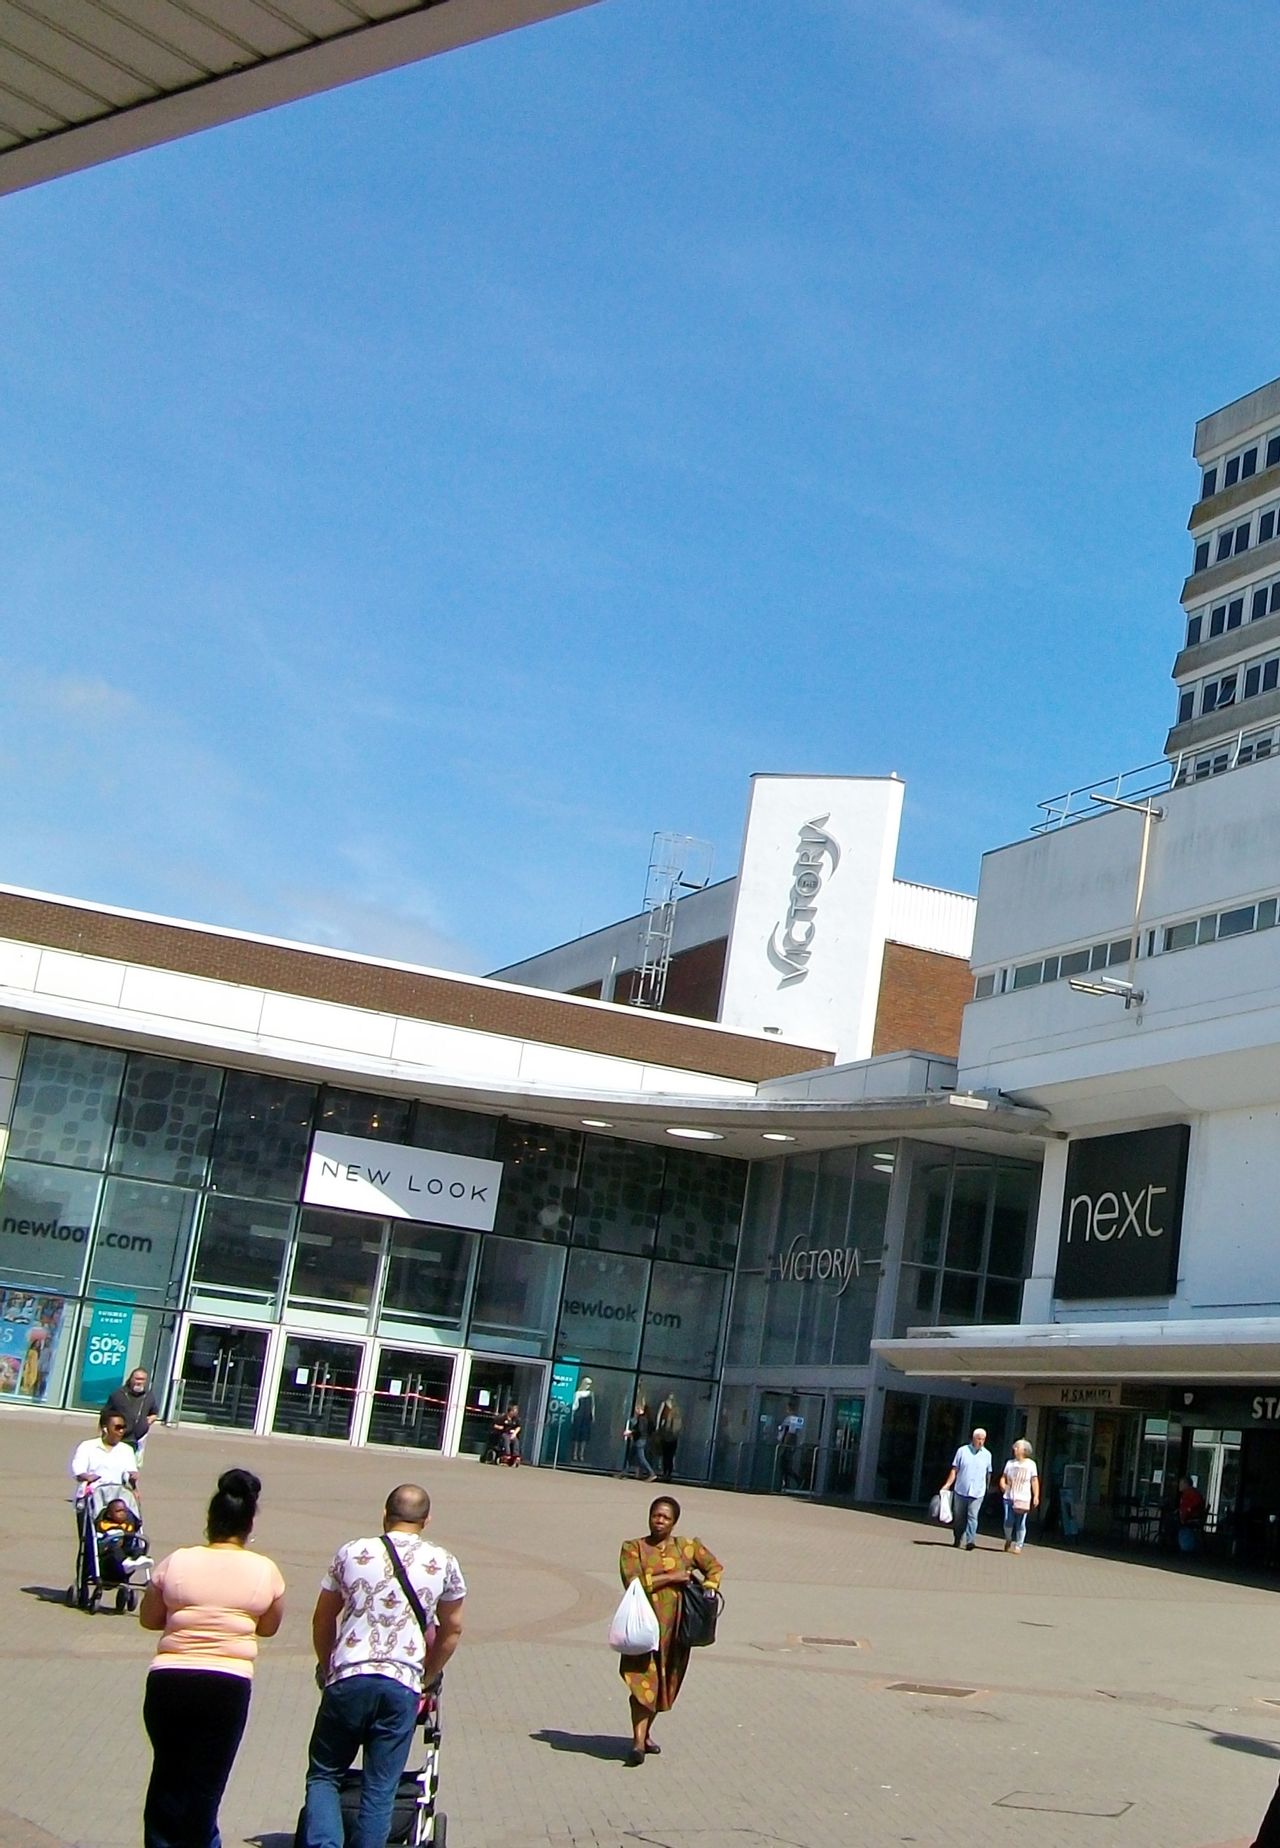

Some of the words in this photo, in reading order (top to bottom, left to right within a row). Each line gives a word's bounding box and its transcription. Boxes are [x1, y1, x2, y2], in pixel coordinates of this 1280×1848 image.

[767, 812, 841, 990] VICTORIA
[321, 1161, 391, 1186] NEW
[408, 1175, 488, 1203] LOOK
[1066, 1184, 1166, 1245] next
[779, 1233, 860, 1297] VICTORIA
[89, 1351, 121, 1366] OFF
[90, 1336, 126, 1353] 50%
[549, 1399, 570, 1414] 0%
